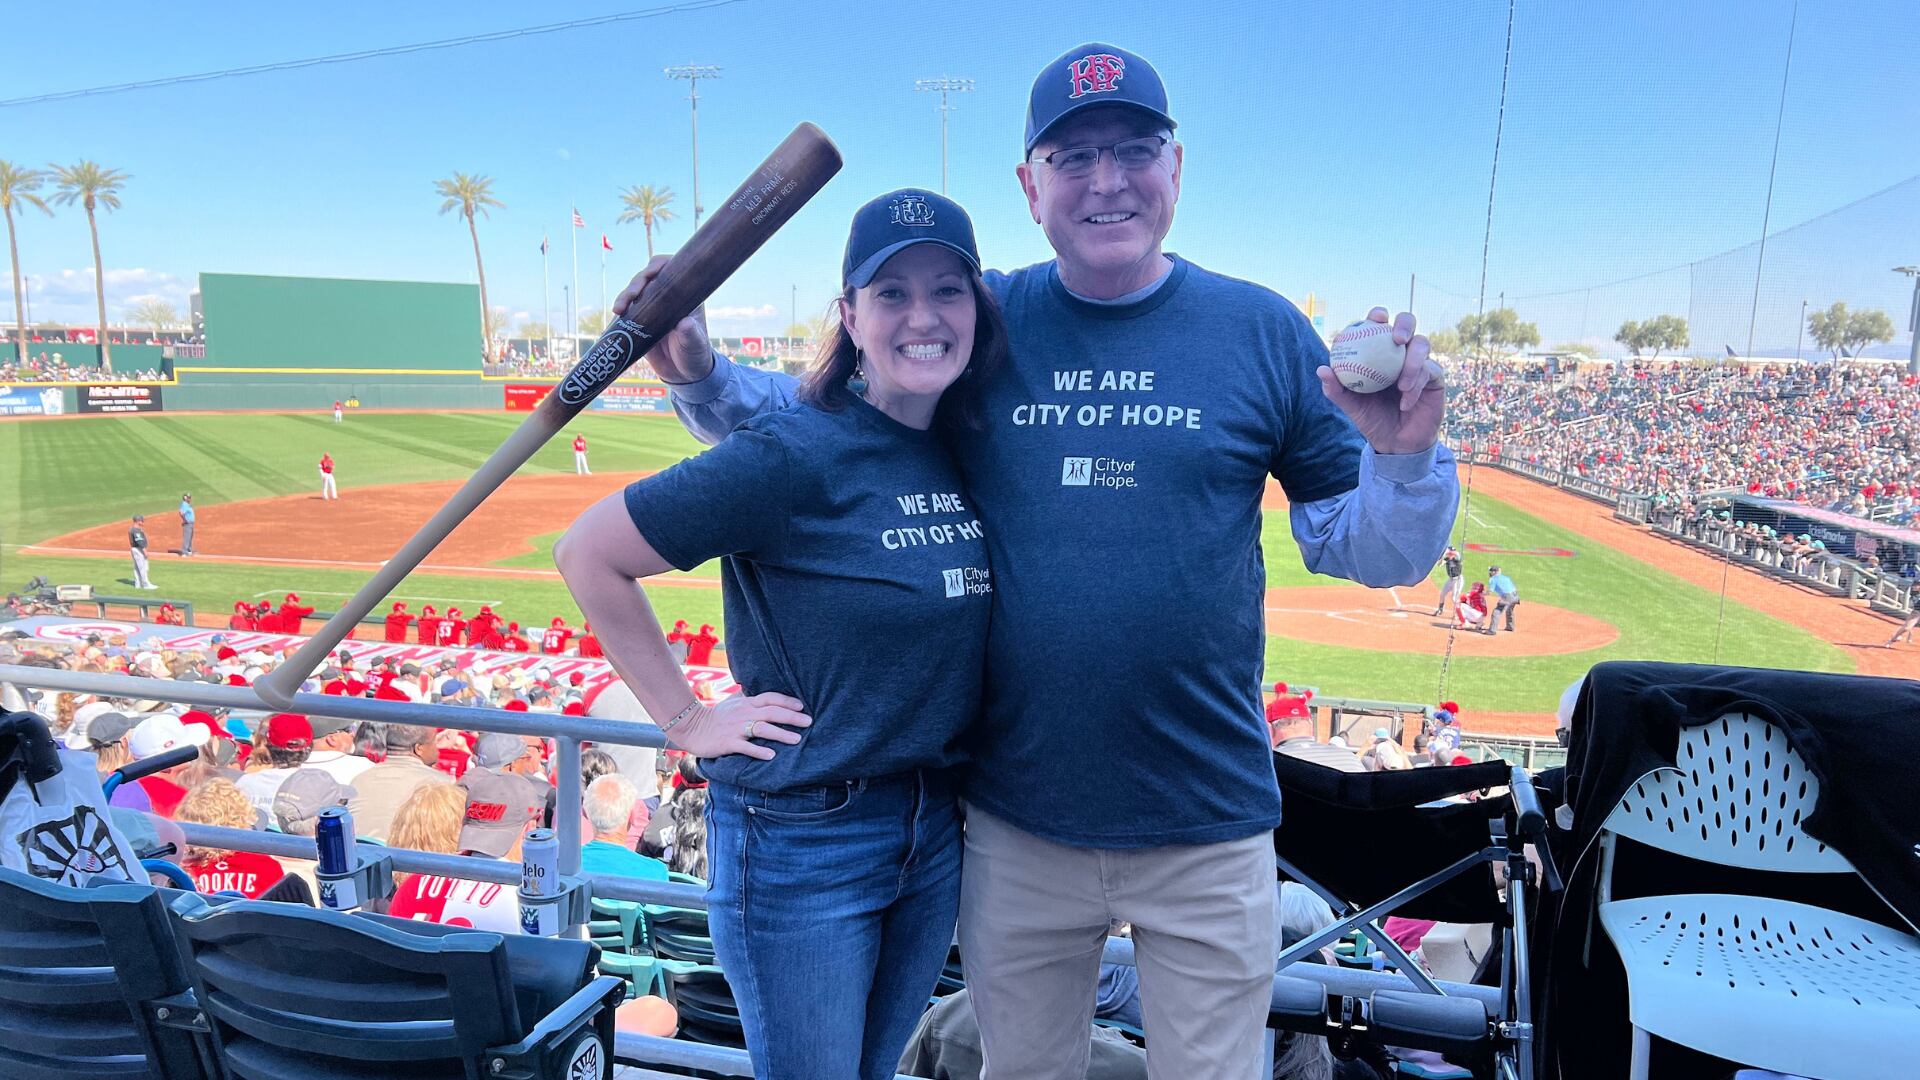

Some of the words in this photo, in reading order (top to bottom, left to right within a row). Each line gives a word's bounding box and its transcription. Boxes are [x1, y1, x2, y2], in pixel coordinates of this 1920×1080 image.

[730, 185, 755, 210] GENUINE
[745, 194, 762, 212] MLB
[761, 173, 785, 195] PRIME
[752, 195, 782, 225] CINCINNATI
[781, 179, 798, 197] REDS
[565, 341, 625, 399] Slugger
[577, 338, 613, 377] LOUISVILLE
[1053, 370, 1093, 391] WE
[1099, 370, 1154, 391] ARE
[1012, 404, 1071, 425] CITY
[1076, 404, 1113, 426] OF
[1121, 404, 1201, 429] HOPE
[897, 494, 929, 515] WE
[932, 493, 965, 513] ARE
[881, 527, 928, 550] CITY
[930, 524, 955, 545] OF
[957, 520, 983, 541] HO
[199, 872, 257, 893] OOKIE
[415, 874, 502, 908] VOTTO
